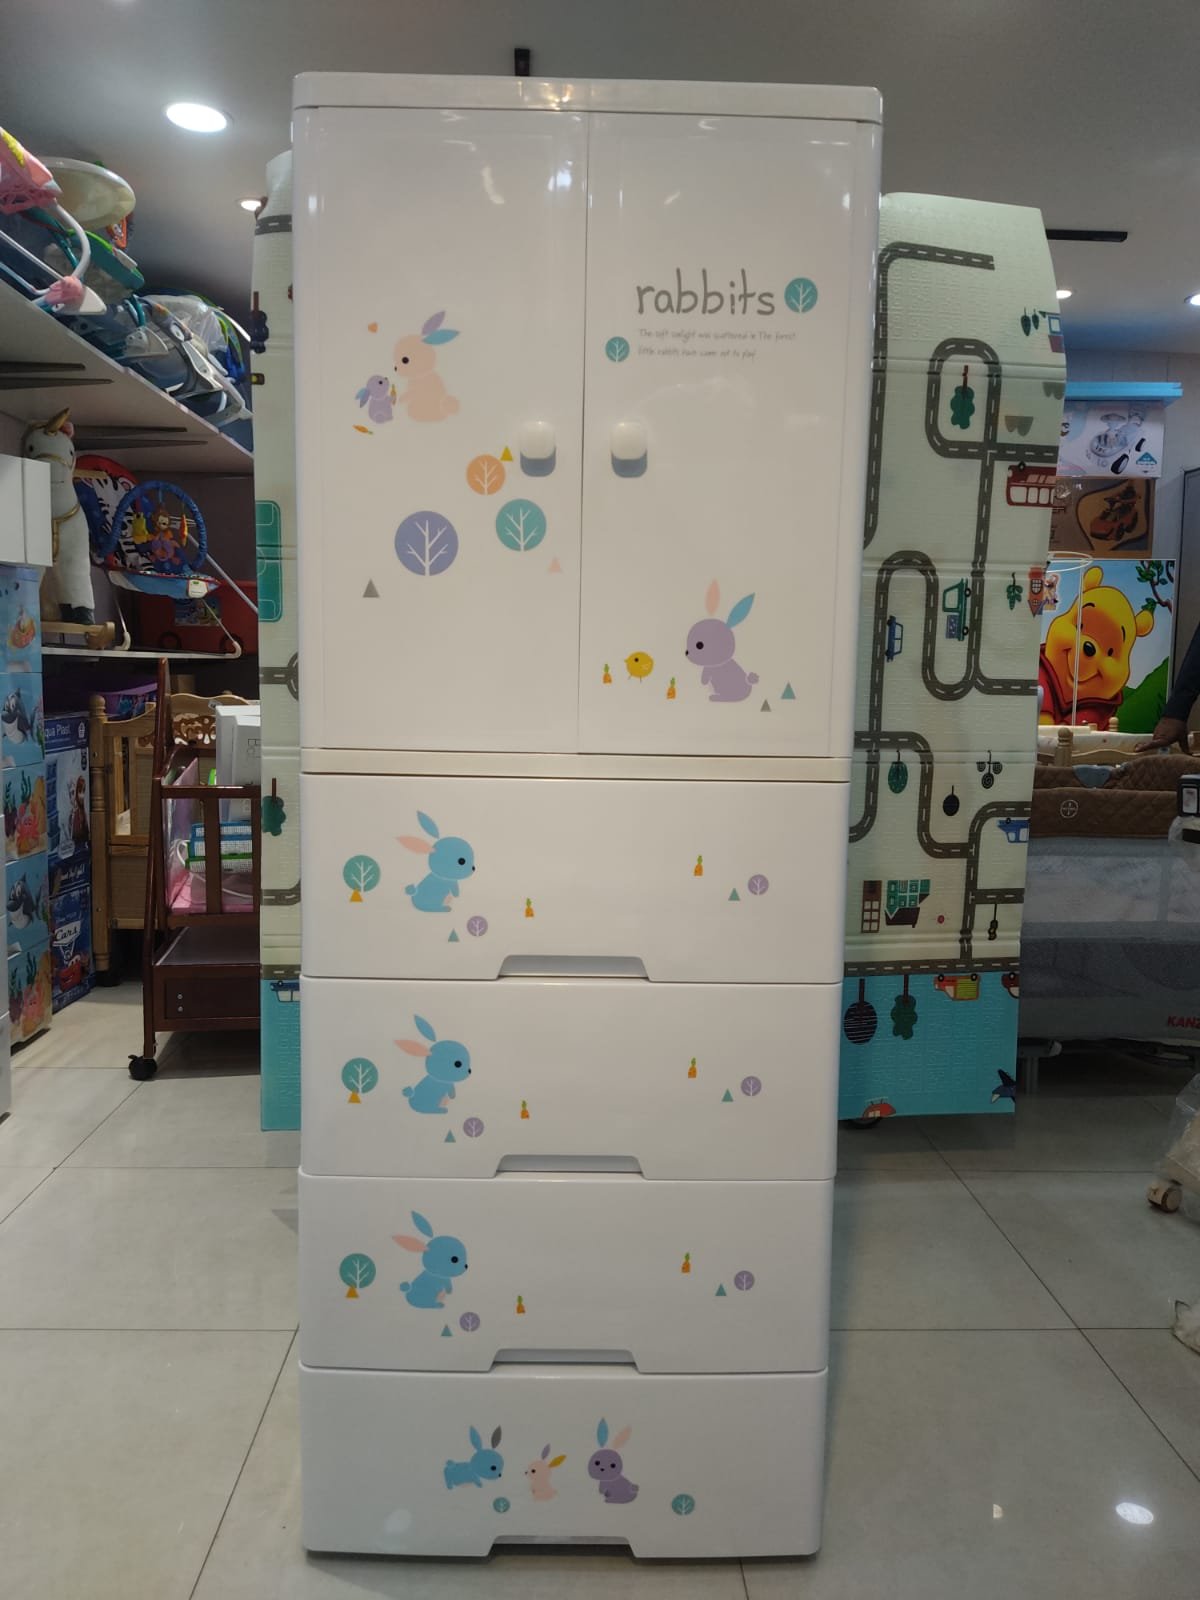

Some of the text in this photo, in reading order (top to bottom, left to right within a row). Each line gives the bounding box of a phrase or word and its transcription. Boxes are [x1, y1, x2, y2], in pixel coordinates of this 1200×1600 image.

[636, 267, 776, 316] rabbits
[45, 728, 55, 738] qua
[55, 926, 77, 940] Cars
